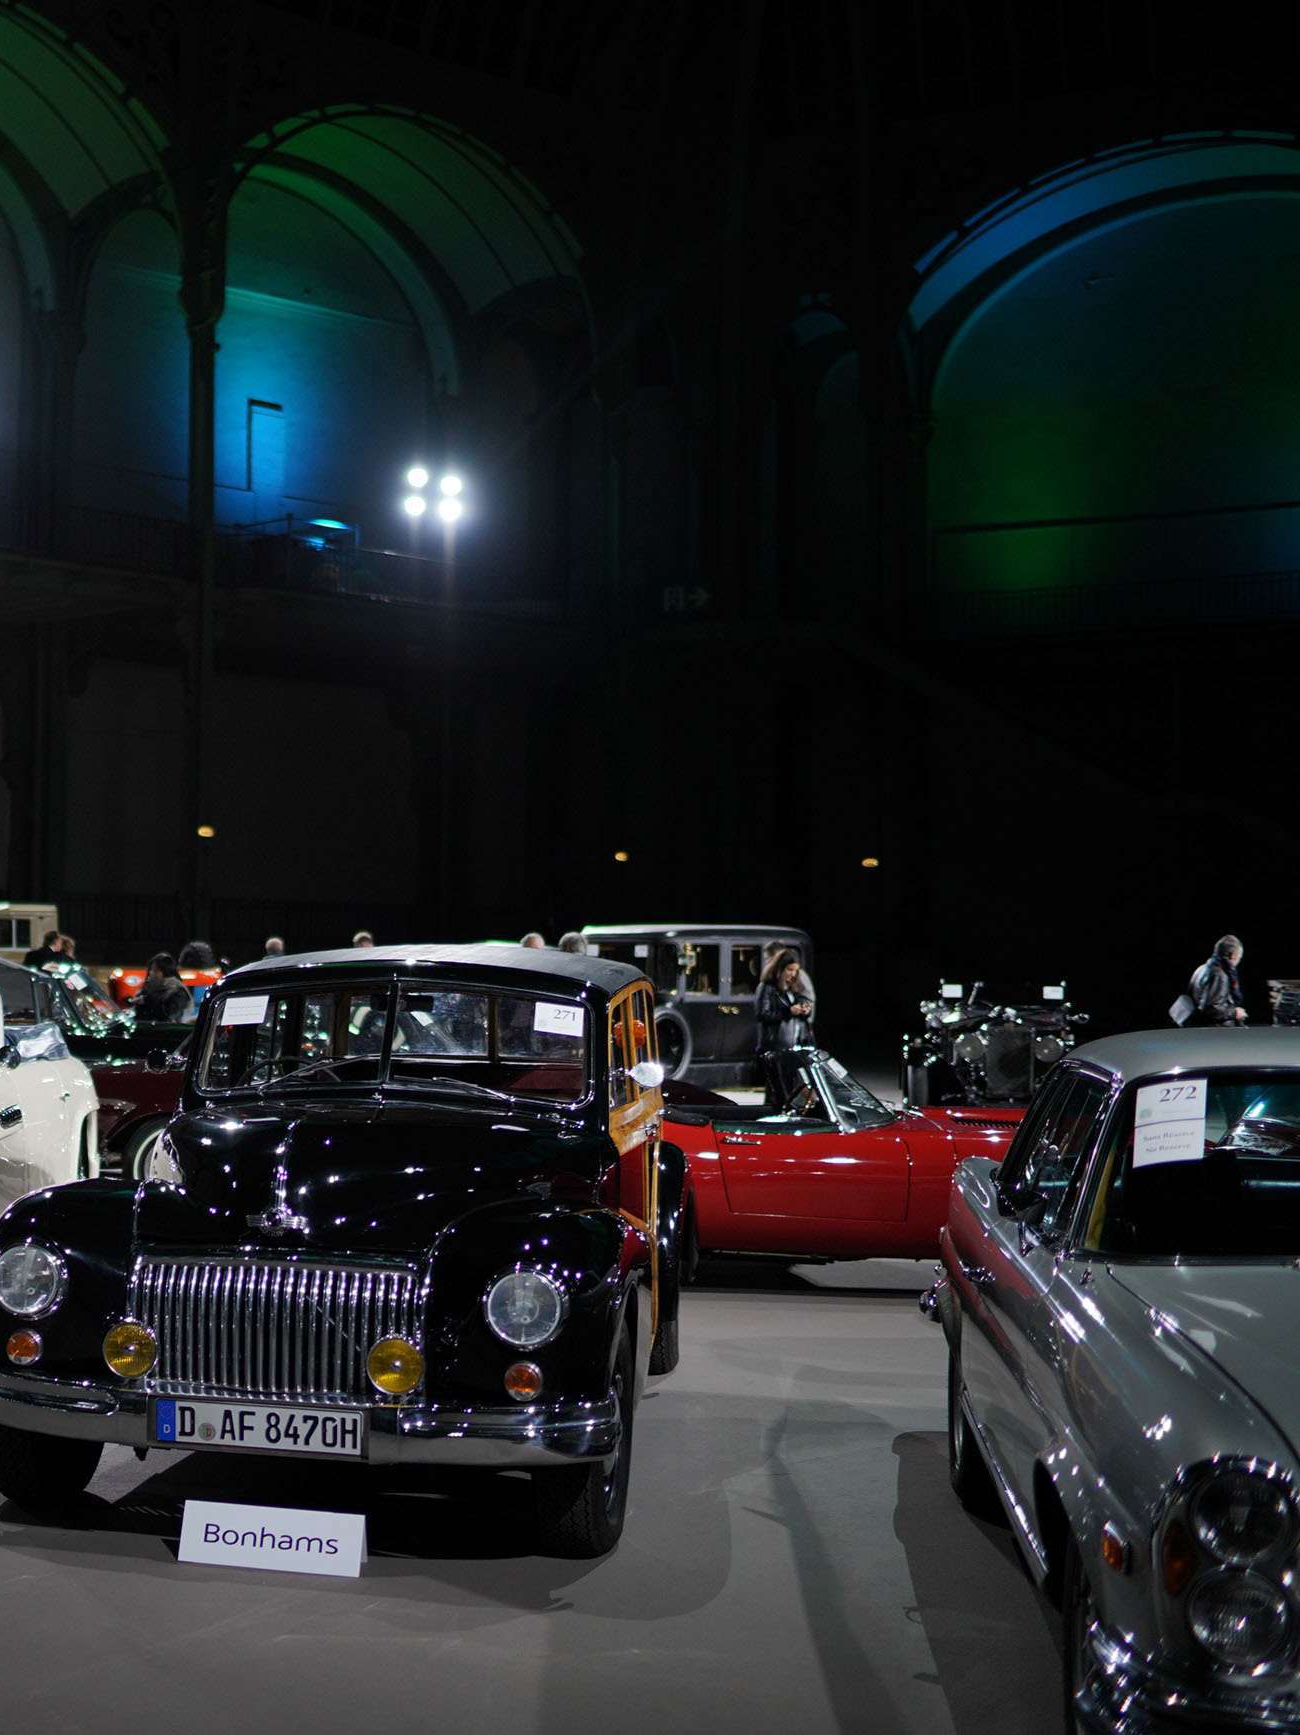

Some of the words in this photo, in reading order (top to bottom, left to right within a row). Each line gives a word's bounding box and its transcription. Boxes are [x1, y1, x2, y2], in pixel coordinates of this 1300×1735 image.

[553, 1008, 576, 1022] 271
[1160, 1085, 1197, 1103] 272
[178, 1406, 196, 1437] D
[220, 1409, 256, 1442] AF
[264, 1412, 359, 1450] 8470H
[203, 1523, 339, 1555] Bonhams
